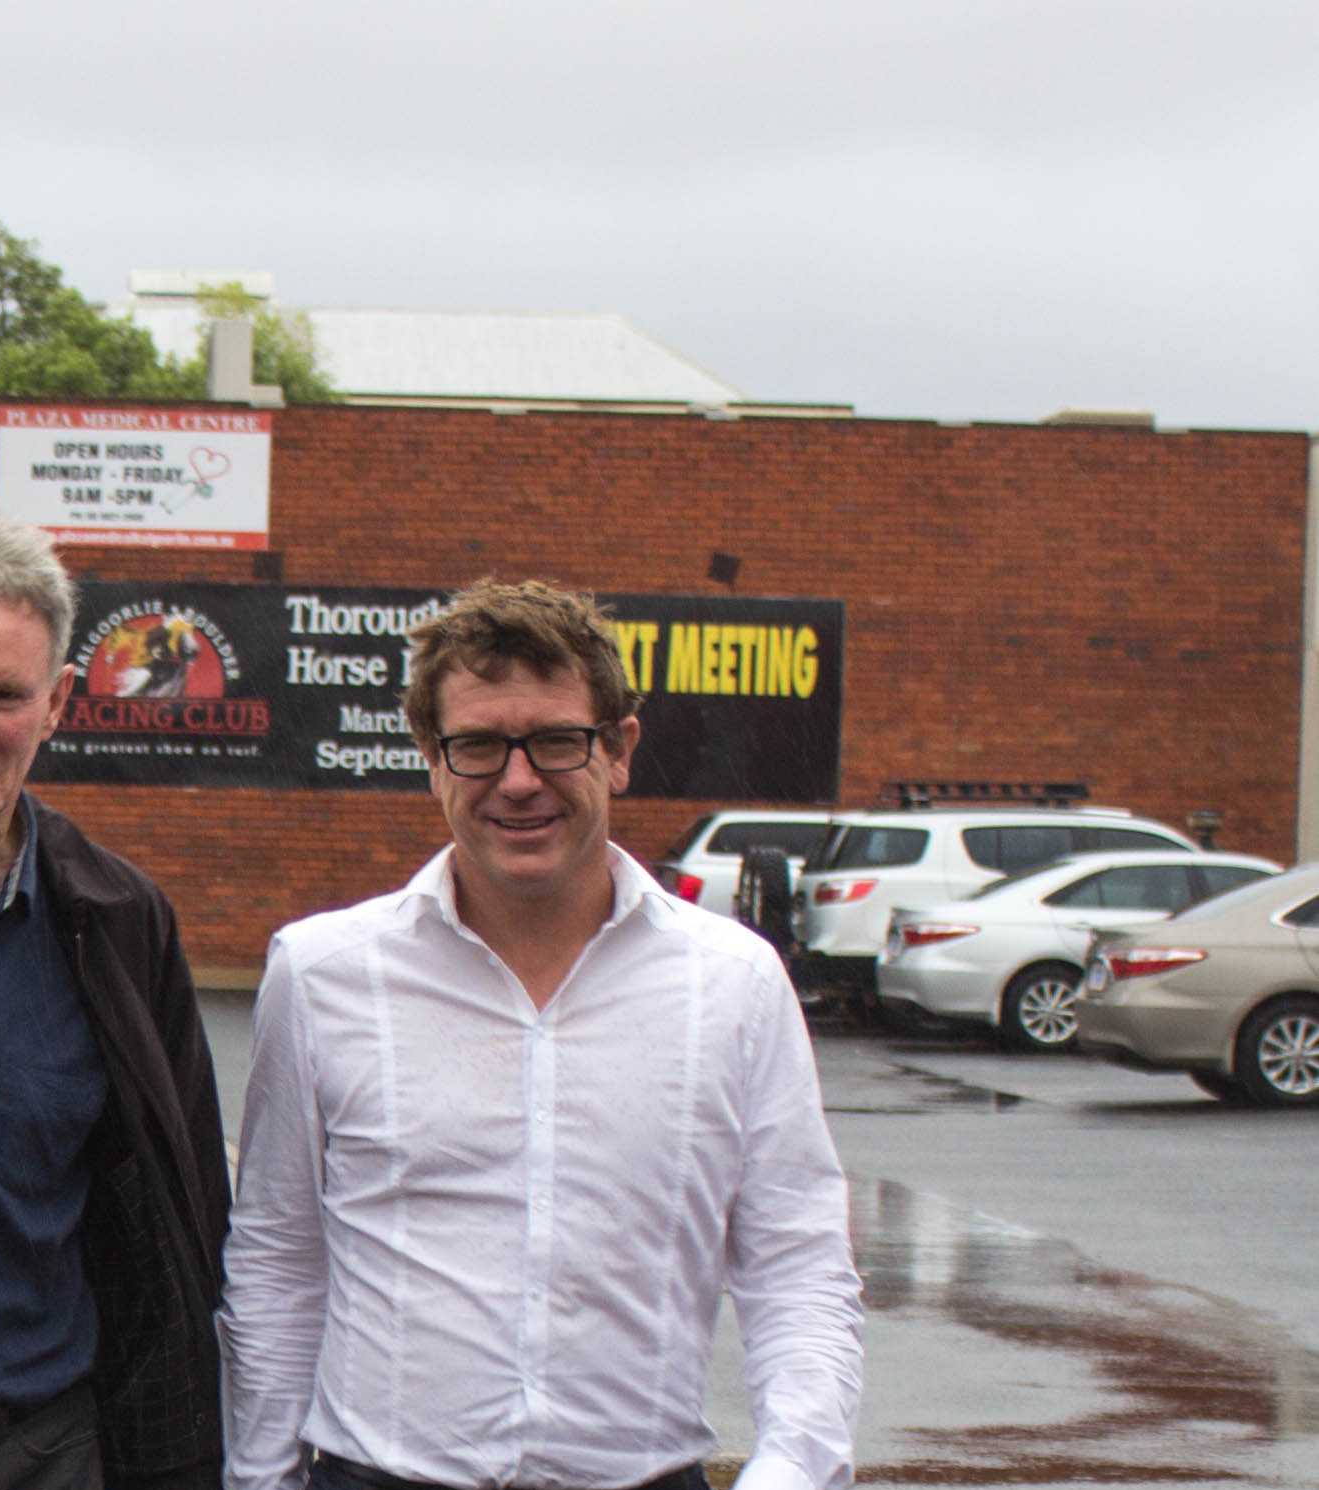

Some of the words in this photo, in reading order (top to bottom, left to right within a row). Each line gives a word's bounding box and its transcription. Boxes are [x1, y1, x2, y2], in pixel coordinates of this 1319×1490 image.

[7, 409, 73, 427] PLAZA
[81, 411, 171, 430] MEDICAL
[180, 413, 260, 432] CENTRE
[54, 442, 99, 459] OPEN
[106, 443, 164, 460] HOURS
[31, 464, 102, 481] MONDAY
[123, 466, 183, 483] FRIDAY
[62, 486, 101, 504] 9AM
[74, 600, 163, 677] KALGOORLIE
[285, 646, 388, 686] Horse
[614, 621, 659, 692] XT
[666, 621, 819, 699] MEETING
[184, 702, 270, 732] CLUB
[49, 741, 77, 752] The
[84, 742, 150, 755] greatest
[156, 743, 193, 754] show
[202, 746, 220, 756] on
[315, 739, 430, 776] Septem
